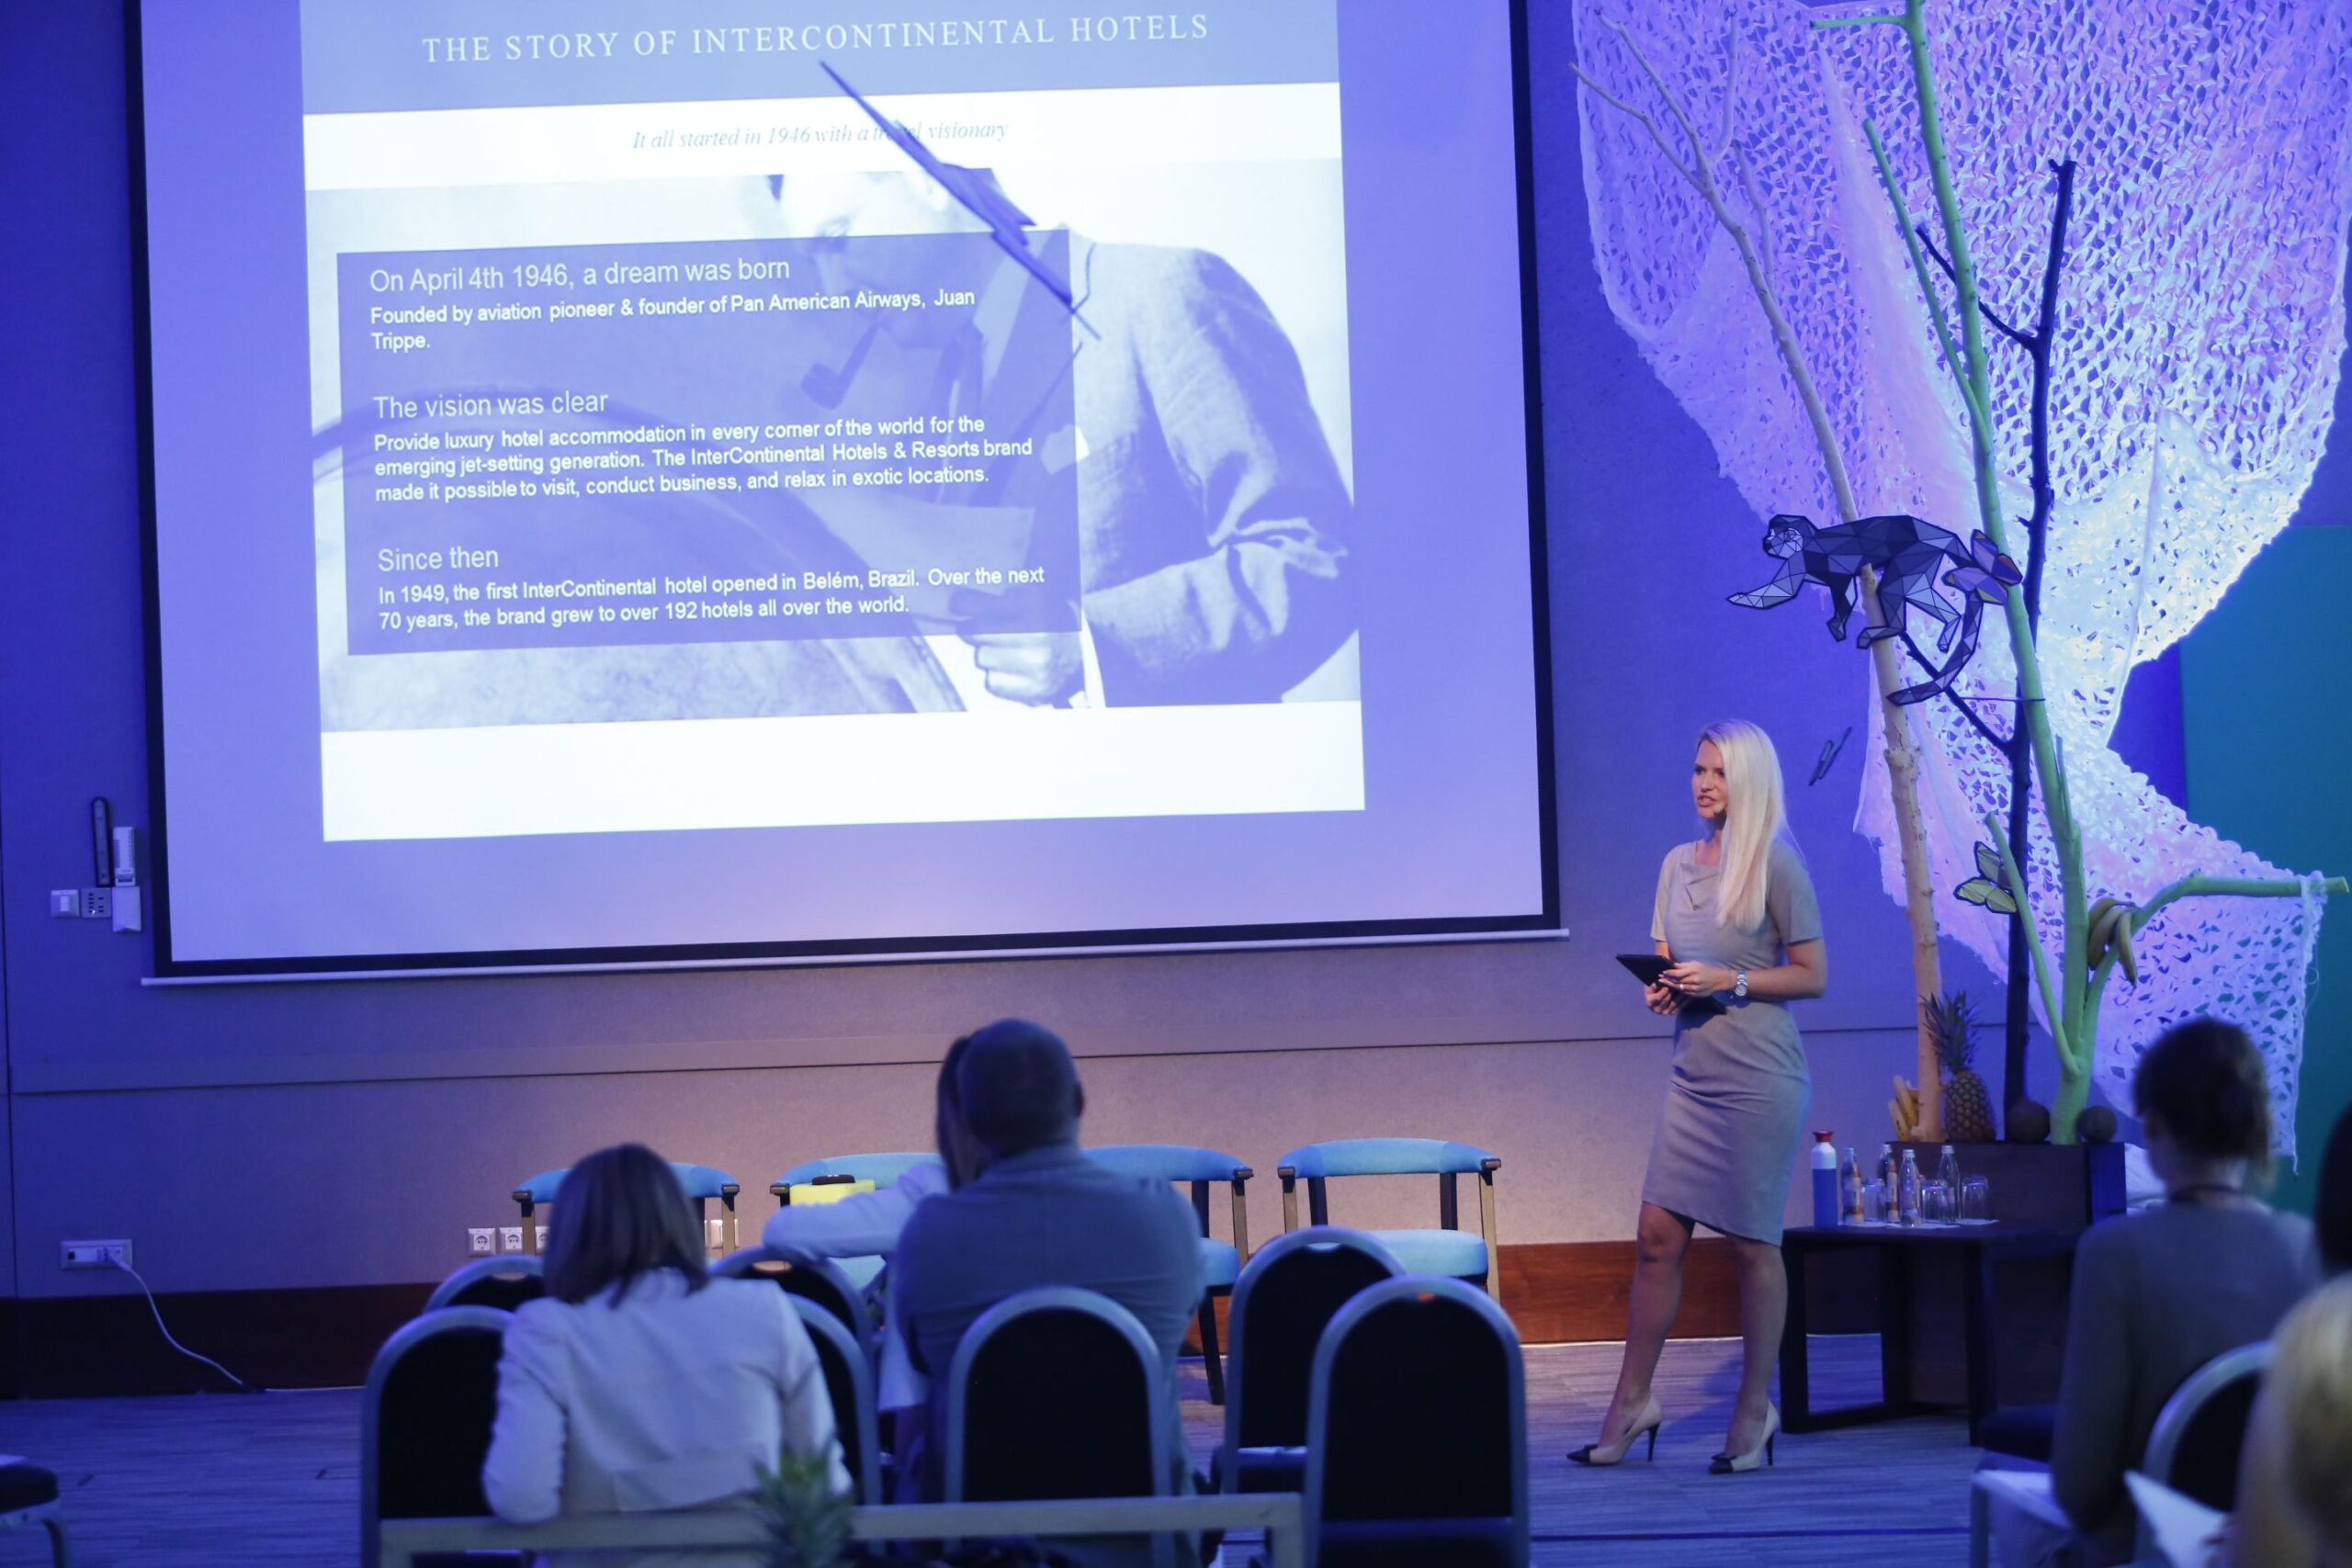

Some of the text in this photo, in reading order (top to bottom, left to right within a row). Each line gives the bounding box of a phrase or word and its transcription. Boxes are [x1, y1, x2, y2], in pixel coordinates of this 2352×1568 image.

[423, 15, 1206, 62] THE STORY OF INTERCONTINENTAL HOTELS
[633, 131, 646, 149] It
[651, 130, 673, 148] all
[680, 129, 740, 148] started
[745, 129, 761, 145] in
[769, 127, 811, 145] 1946
[815, 124, 852, 142] with
[857, 128, 868, 142] a
[929, 121, 1008, 142] visionary
[370, 258, 789, 296] On April 4th 1946, a dream was born
[371, 288, 975, 325] Founded by aviation pioneer & founder of Pan American Airways, Juan
[371, 333, 430, 353] Trippe.
[374, 390, 608, 418] The vision was clear
[375, 415, 984, 452] Provide luxury hotel accommodation in every corner of the world for the
[375, 438, 1032, 479] emerging jet-setting generation. The InterContinental Hotels & Resorts brand
[376, 466, 989, 502] made it possible to visit, conduct business, and relax in exotic locations.
[379, 546, 498, 571] Since then
[379, 567, 1045, 604] In 1949, the first InterContinental hotel opened in Belém, Brazil. Over the next
[379, 595, 909, 633] 70 years, the brand grew to over 192 hotels all over the world.
